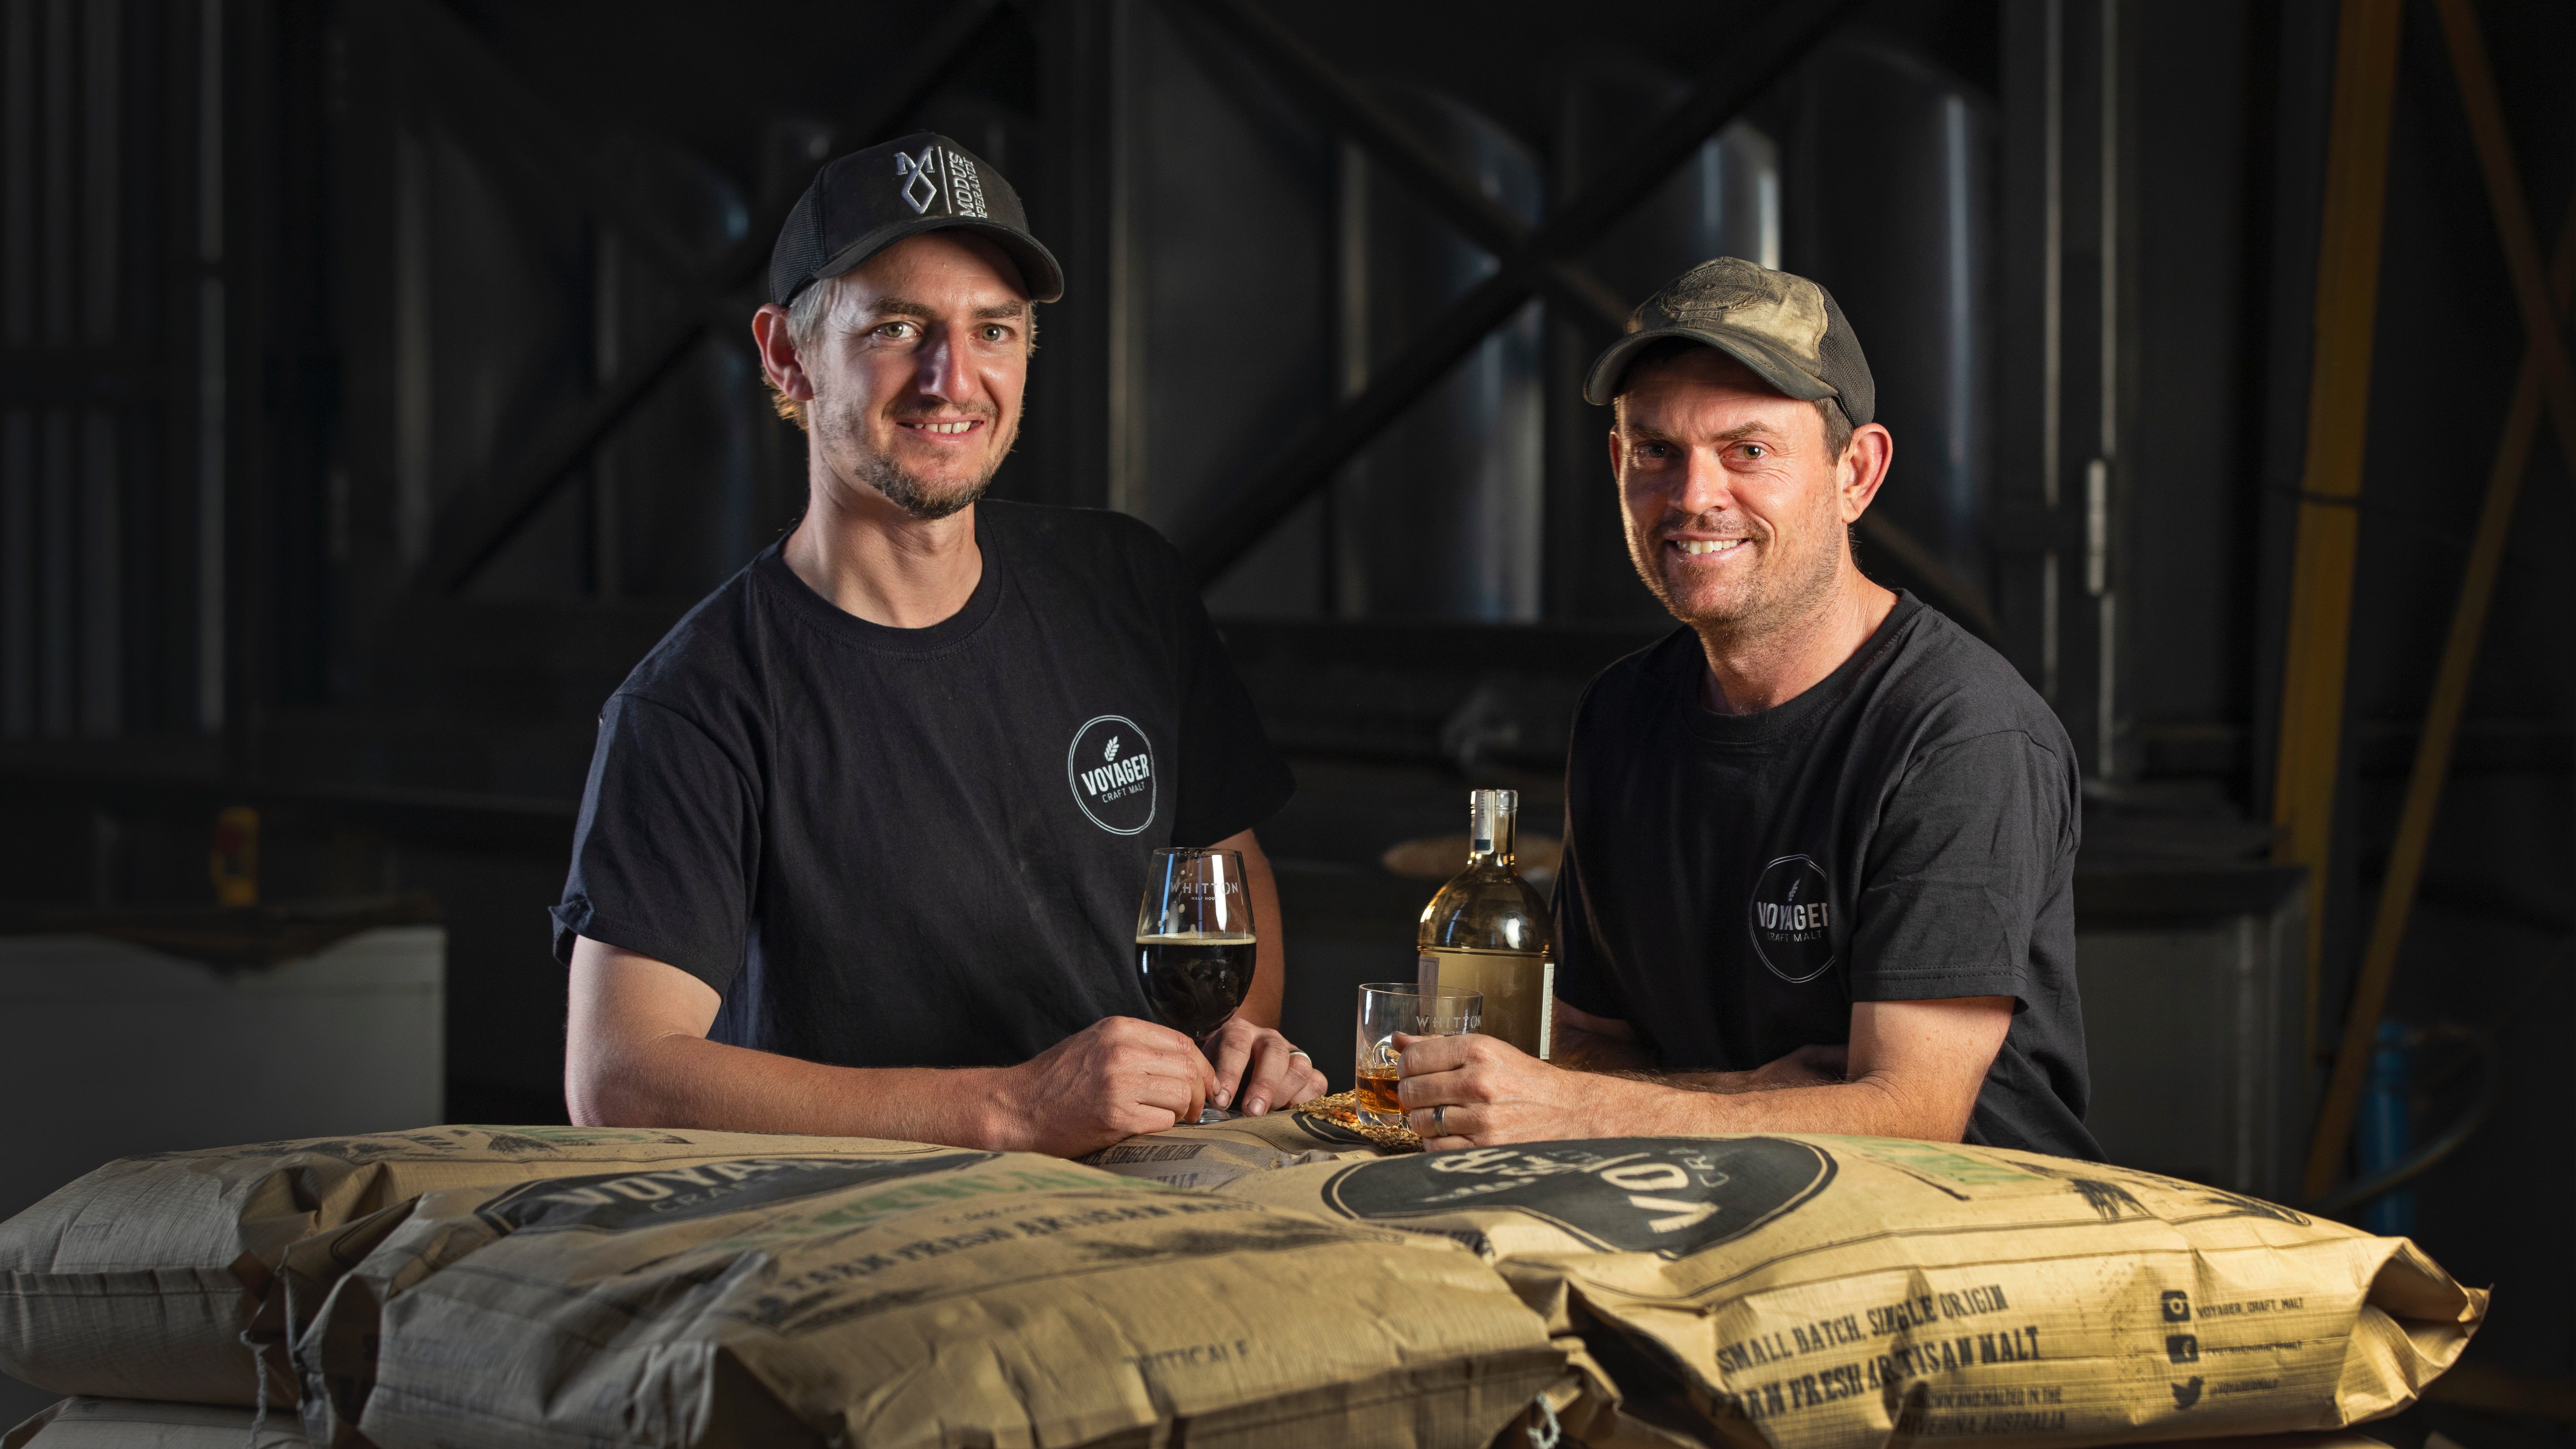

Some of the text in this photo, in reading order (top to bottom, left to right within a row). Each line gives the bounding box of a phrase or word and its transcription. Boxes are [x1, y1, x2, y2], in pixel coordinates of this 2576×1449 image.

[948, 151, 977, 217] MODUS
[1080, 753, 1150, 796] VOYAGER
[1101, 781, 1145, 803] CRAFT MALT
[1170, 882, 1239, 895] WHITTON
[1793, 930, 1822, 942] MALT
[1105, 1145, 1161, 1165] SINGLE
[1151, 1144, 1208, 1162] ORIGIN
[1716, 1331, 1793, 1376] SMALL
[1867, 1295, 1940, 1338] SINGLE
[1940, 1284, 2009, 1319] ORIGIN
[1788, 1363, 1865, 1411] FRESH
[1868, 1335, 1974, 1390] ARTISAN
[1978, 1326, 2041, 1364] MALT
[2028, 1388, 2040, 1404] IN
